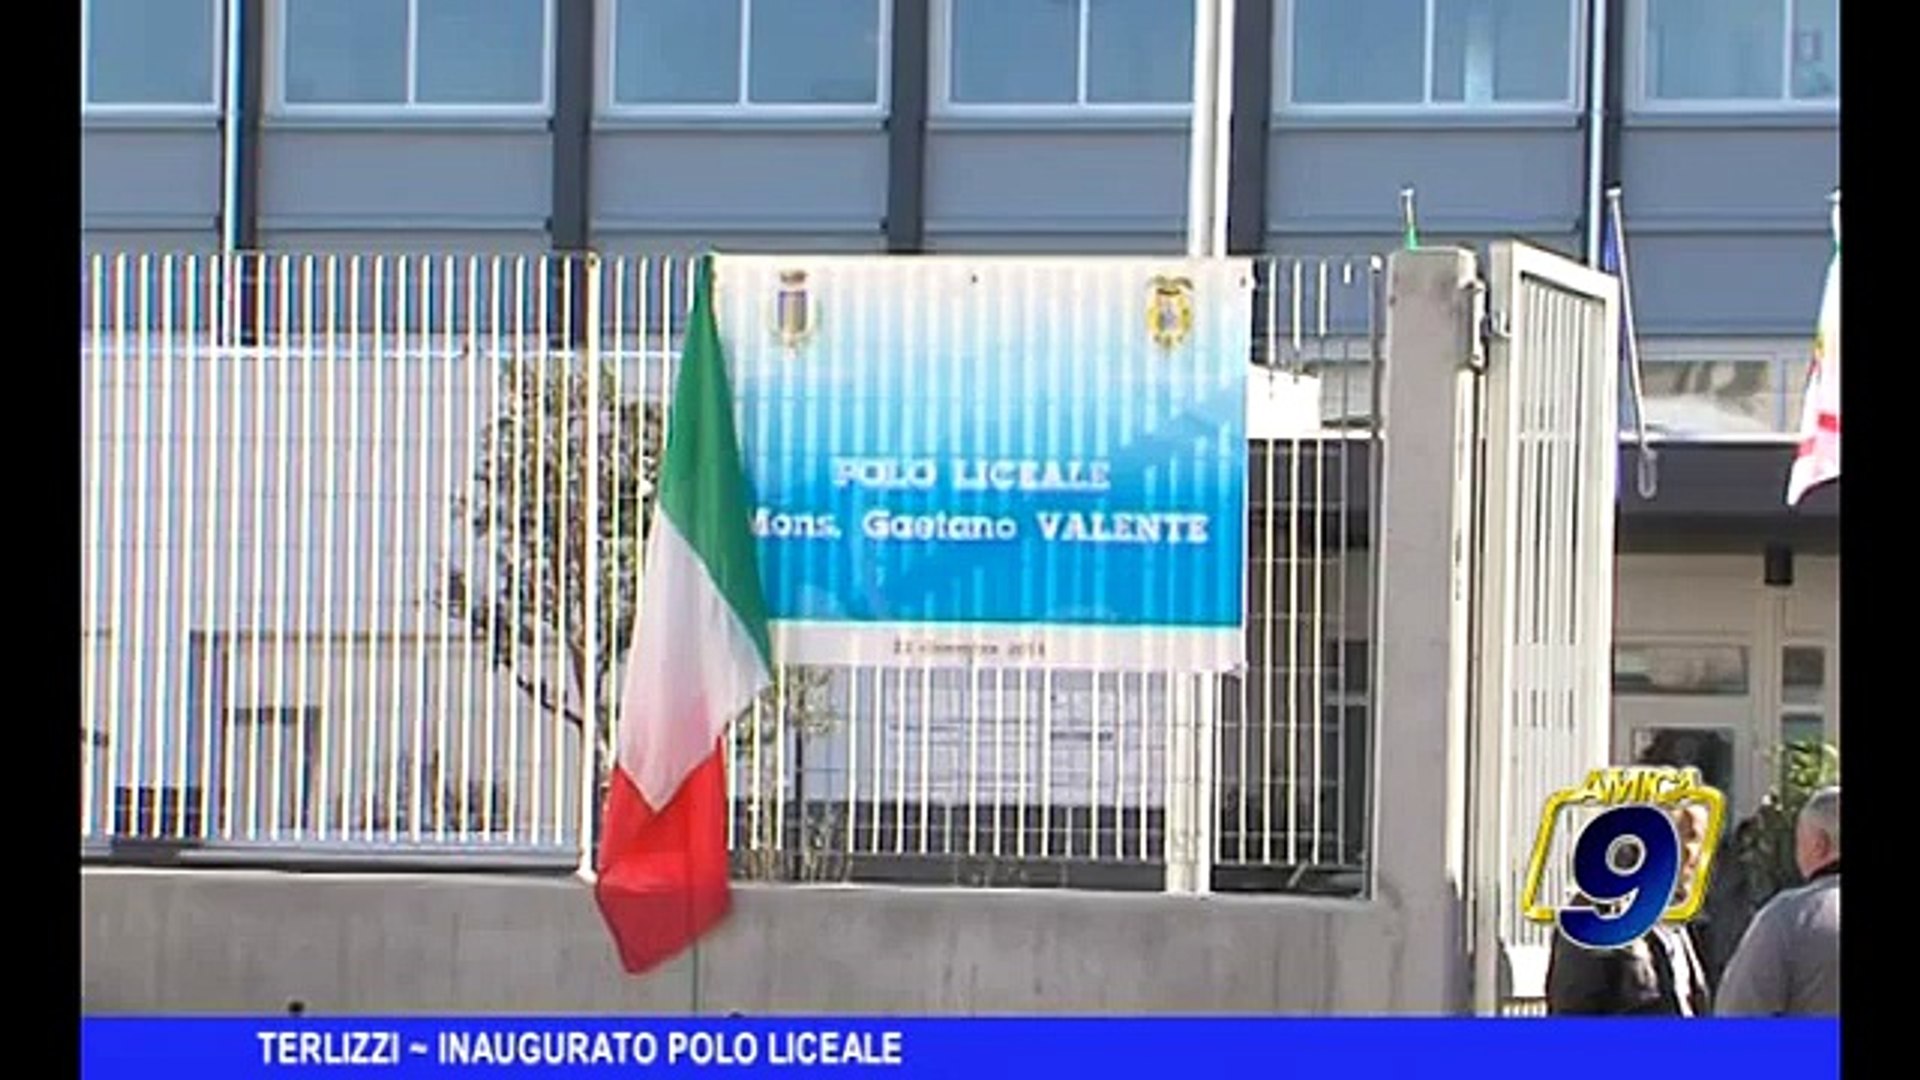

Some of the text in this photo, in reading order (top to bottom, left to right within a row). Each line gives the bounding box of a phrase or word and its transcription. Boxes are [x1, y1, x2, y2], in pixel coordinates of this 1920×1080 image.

[834, 457, 1112, 491] POLO LICEALE
[862, 508, 1018, 541] Gaetano
[1036, 511, 1208, 543] VALENTE
